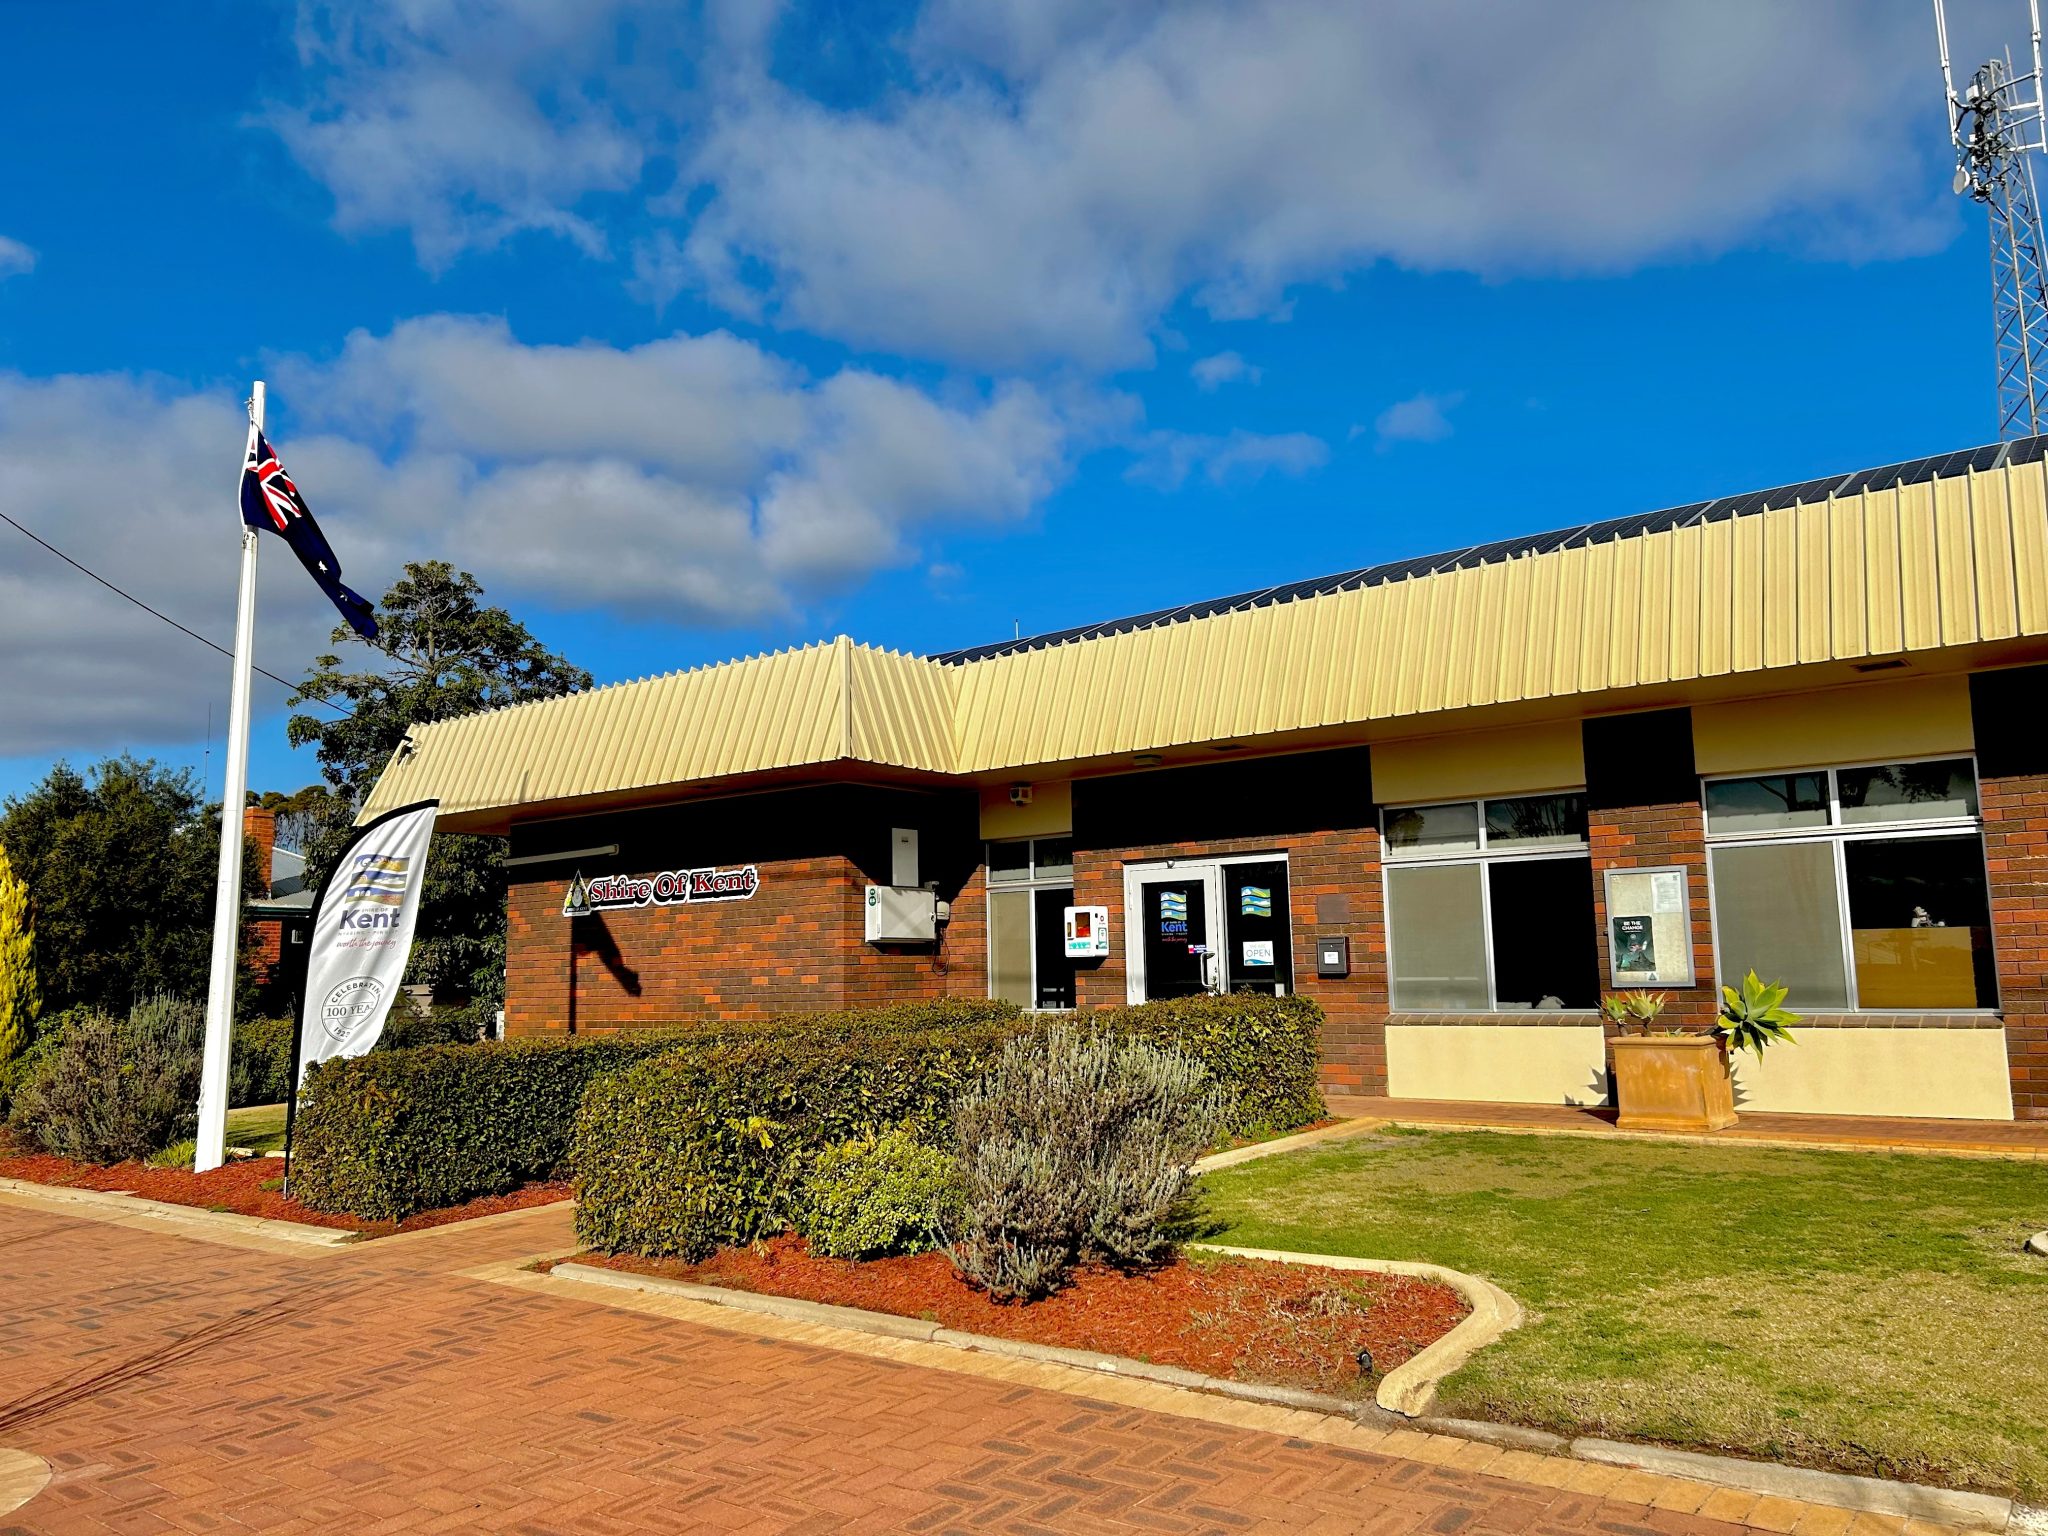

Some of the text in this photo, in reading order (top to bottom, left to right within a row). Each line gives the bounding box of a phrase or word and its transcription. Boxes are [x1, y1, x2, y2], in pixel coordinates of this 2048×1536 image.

[590, 869, 756, 902] Shire Of Kent
[339, 907, 400, 930] Kent
[1161, 921, 1188, 933] Kent
[1245, 949, 1271, 958] OPEN
[331, 981, 381, 1003] CELEBRATIN
[327, 1004, 371, 1017] 100 YEA
